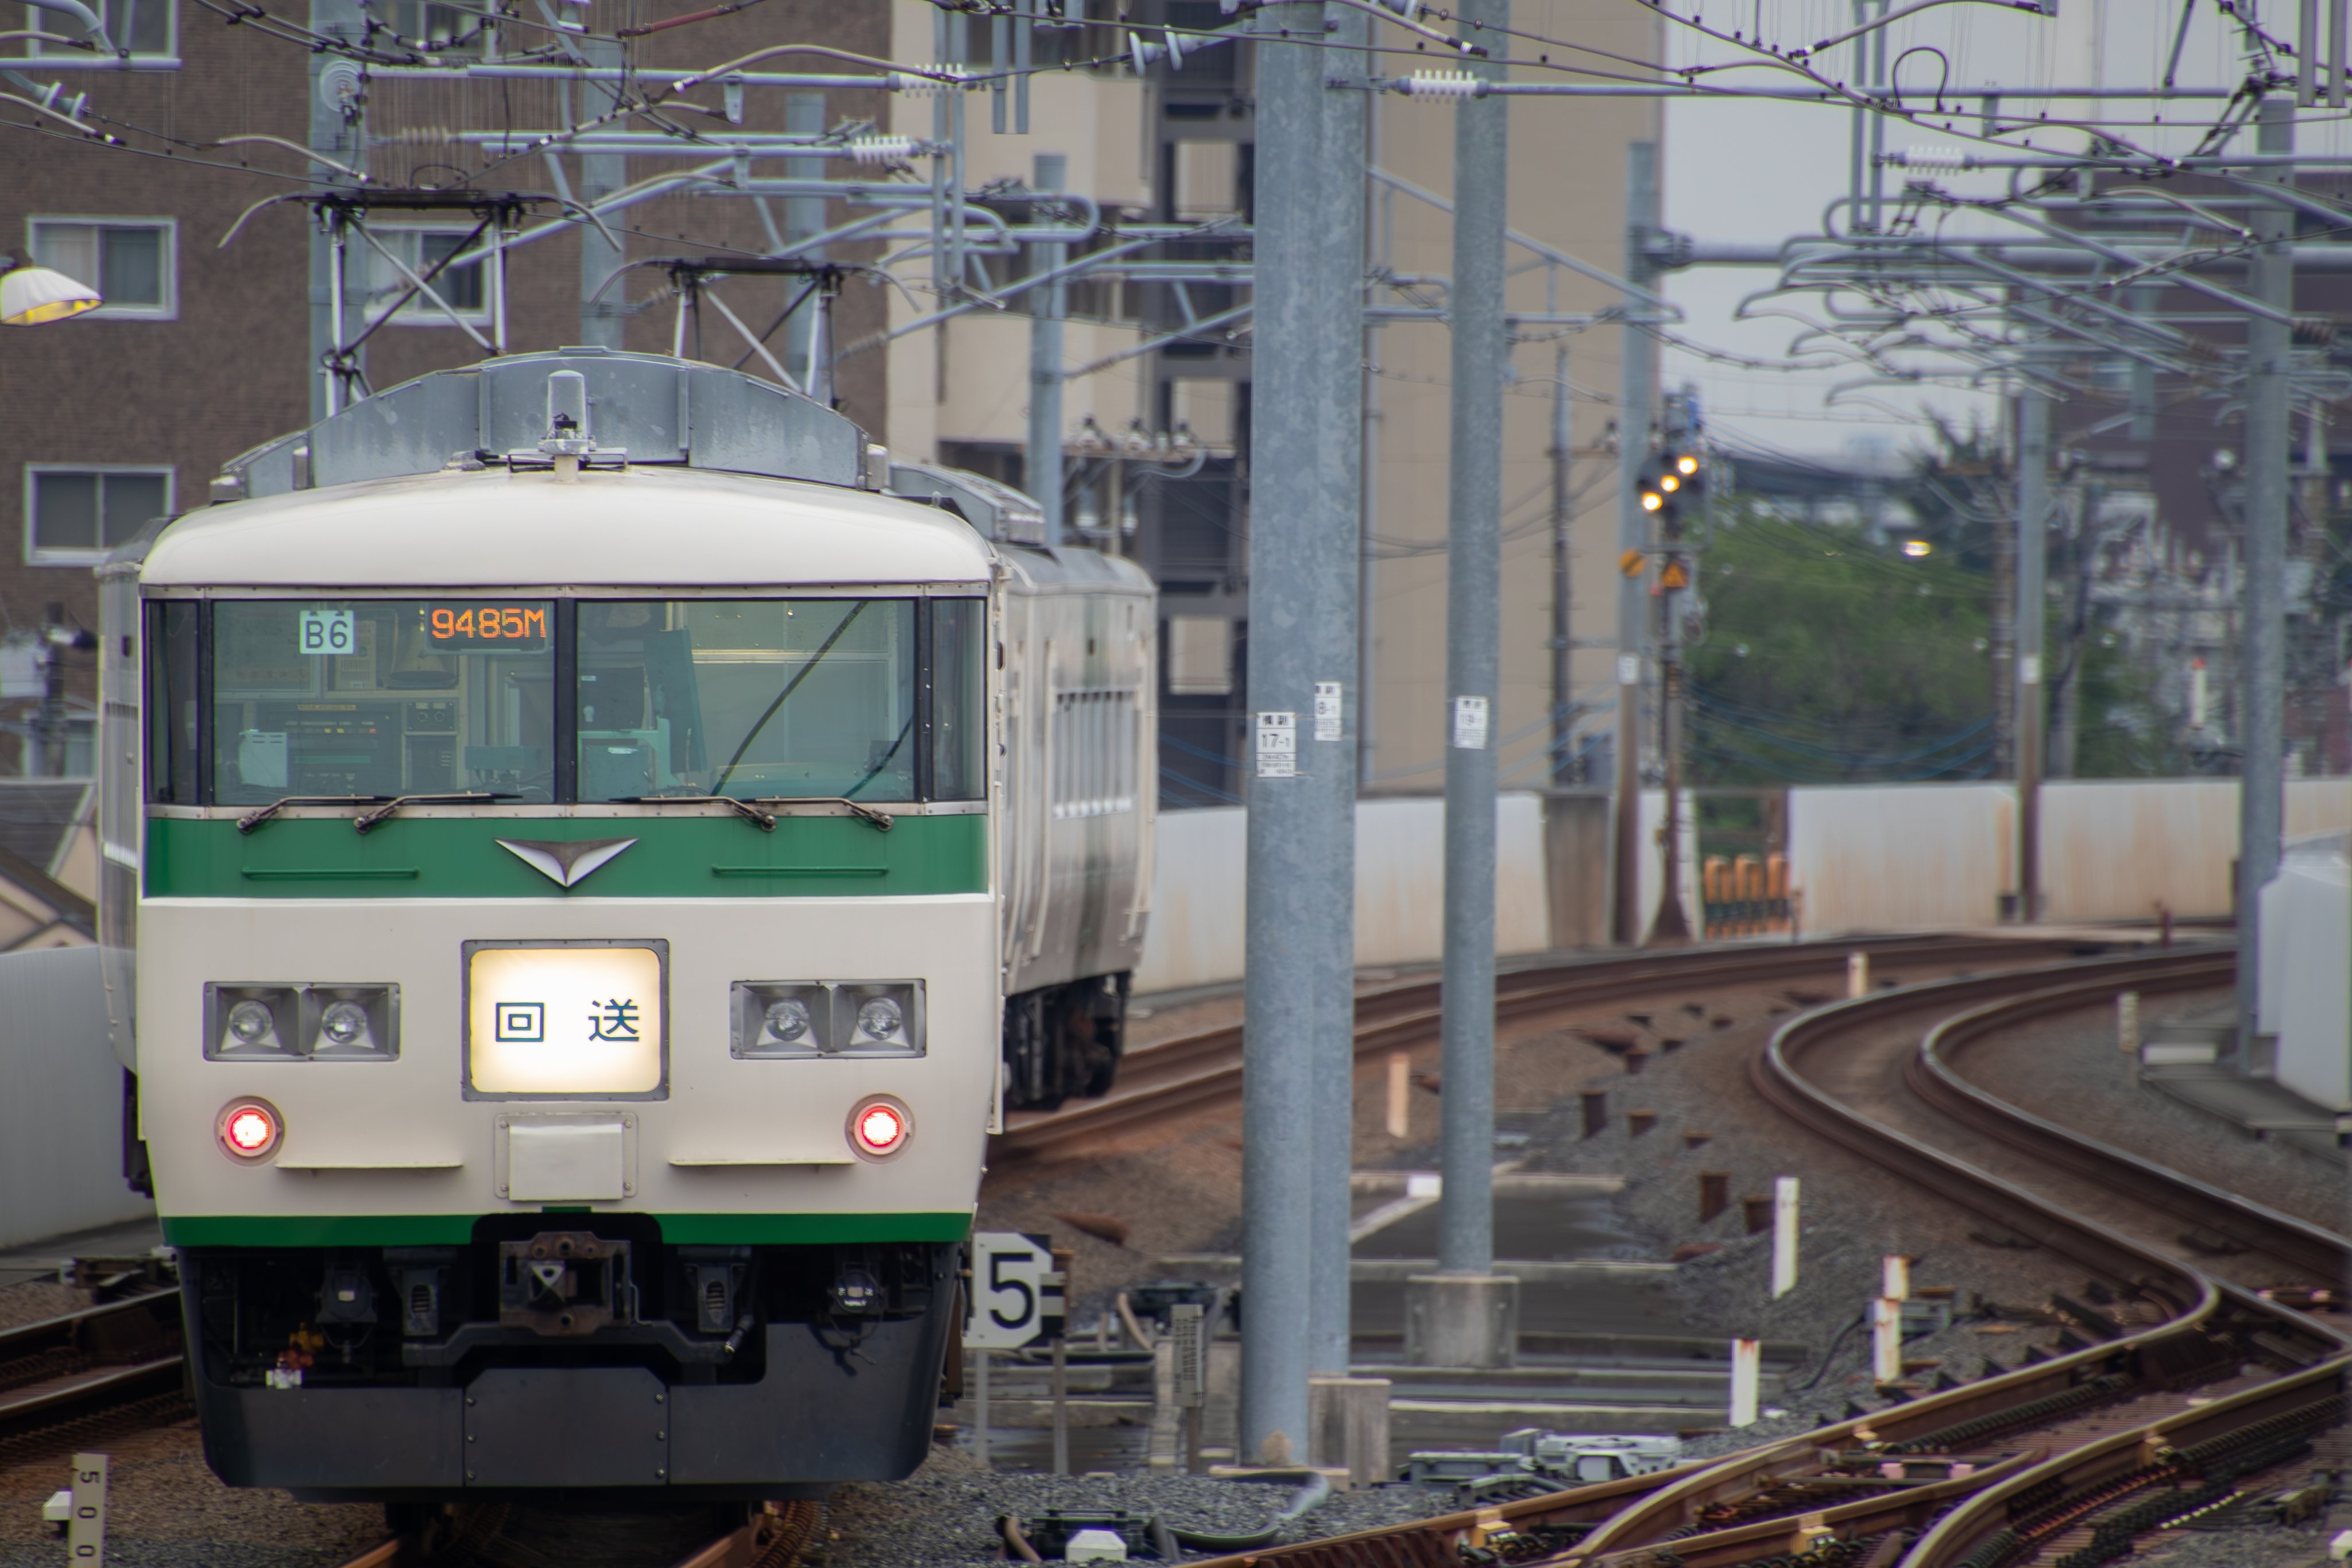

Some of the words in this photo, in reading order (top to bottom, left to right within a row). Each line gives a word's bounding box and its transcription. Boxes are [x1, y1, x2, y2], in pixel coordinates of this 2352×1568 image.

[305, 620, 348, 649] B6
[432, 607, 546, 639] 9485M
[1262, 733, 1291, 748] 17-1
[495, 998, 640, 1043] 回送
[989, 1252, 1034, 1329] 5
